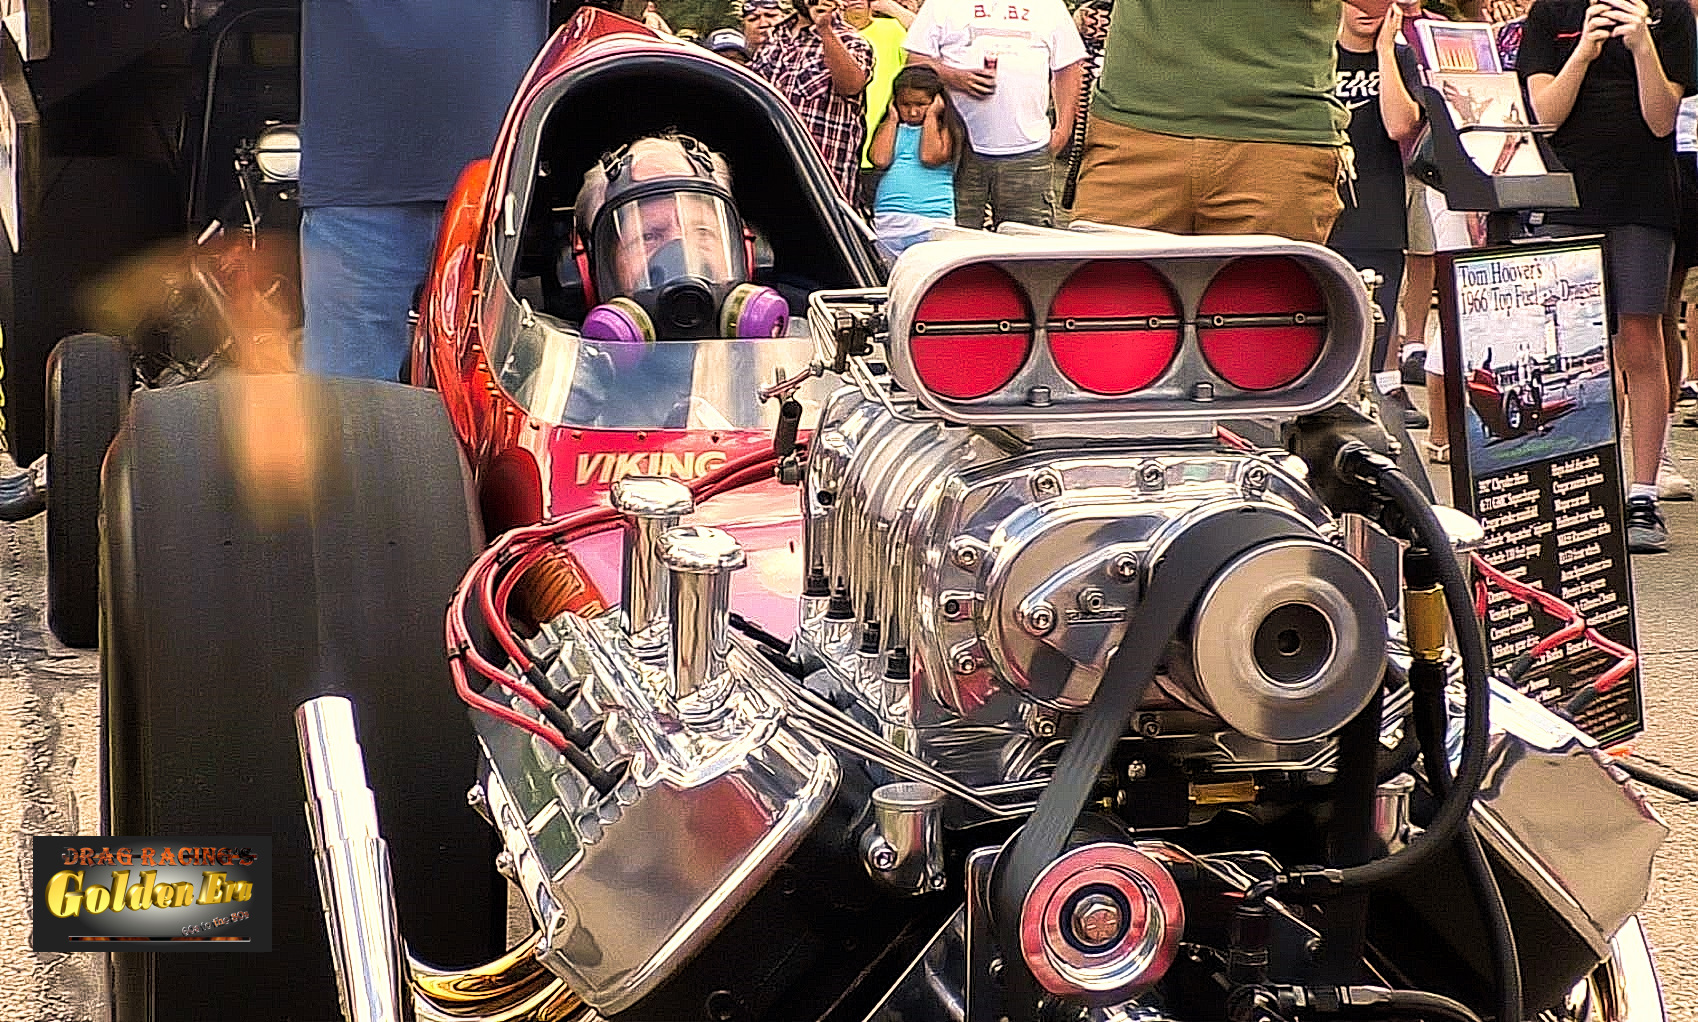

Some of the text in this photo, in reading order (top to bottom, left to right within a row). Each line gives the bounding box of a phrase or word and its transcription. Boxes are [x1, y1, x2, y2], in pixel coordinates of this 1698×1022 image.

[1459, 257, 1543, 288] Tom Hoover's
[1461, 287, 1488, 316] 1966
[1491, 286, 1512, 317] Top
[1515, 283, 1540, 307] Fuel
[575, 450, 728, 486] VIKING
